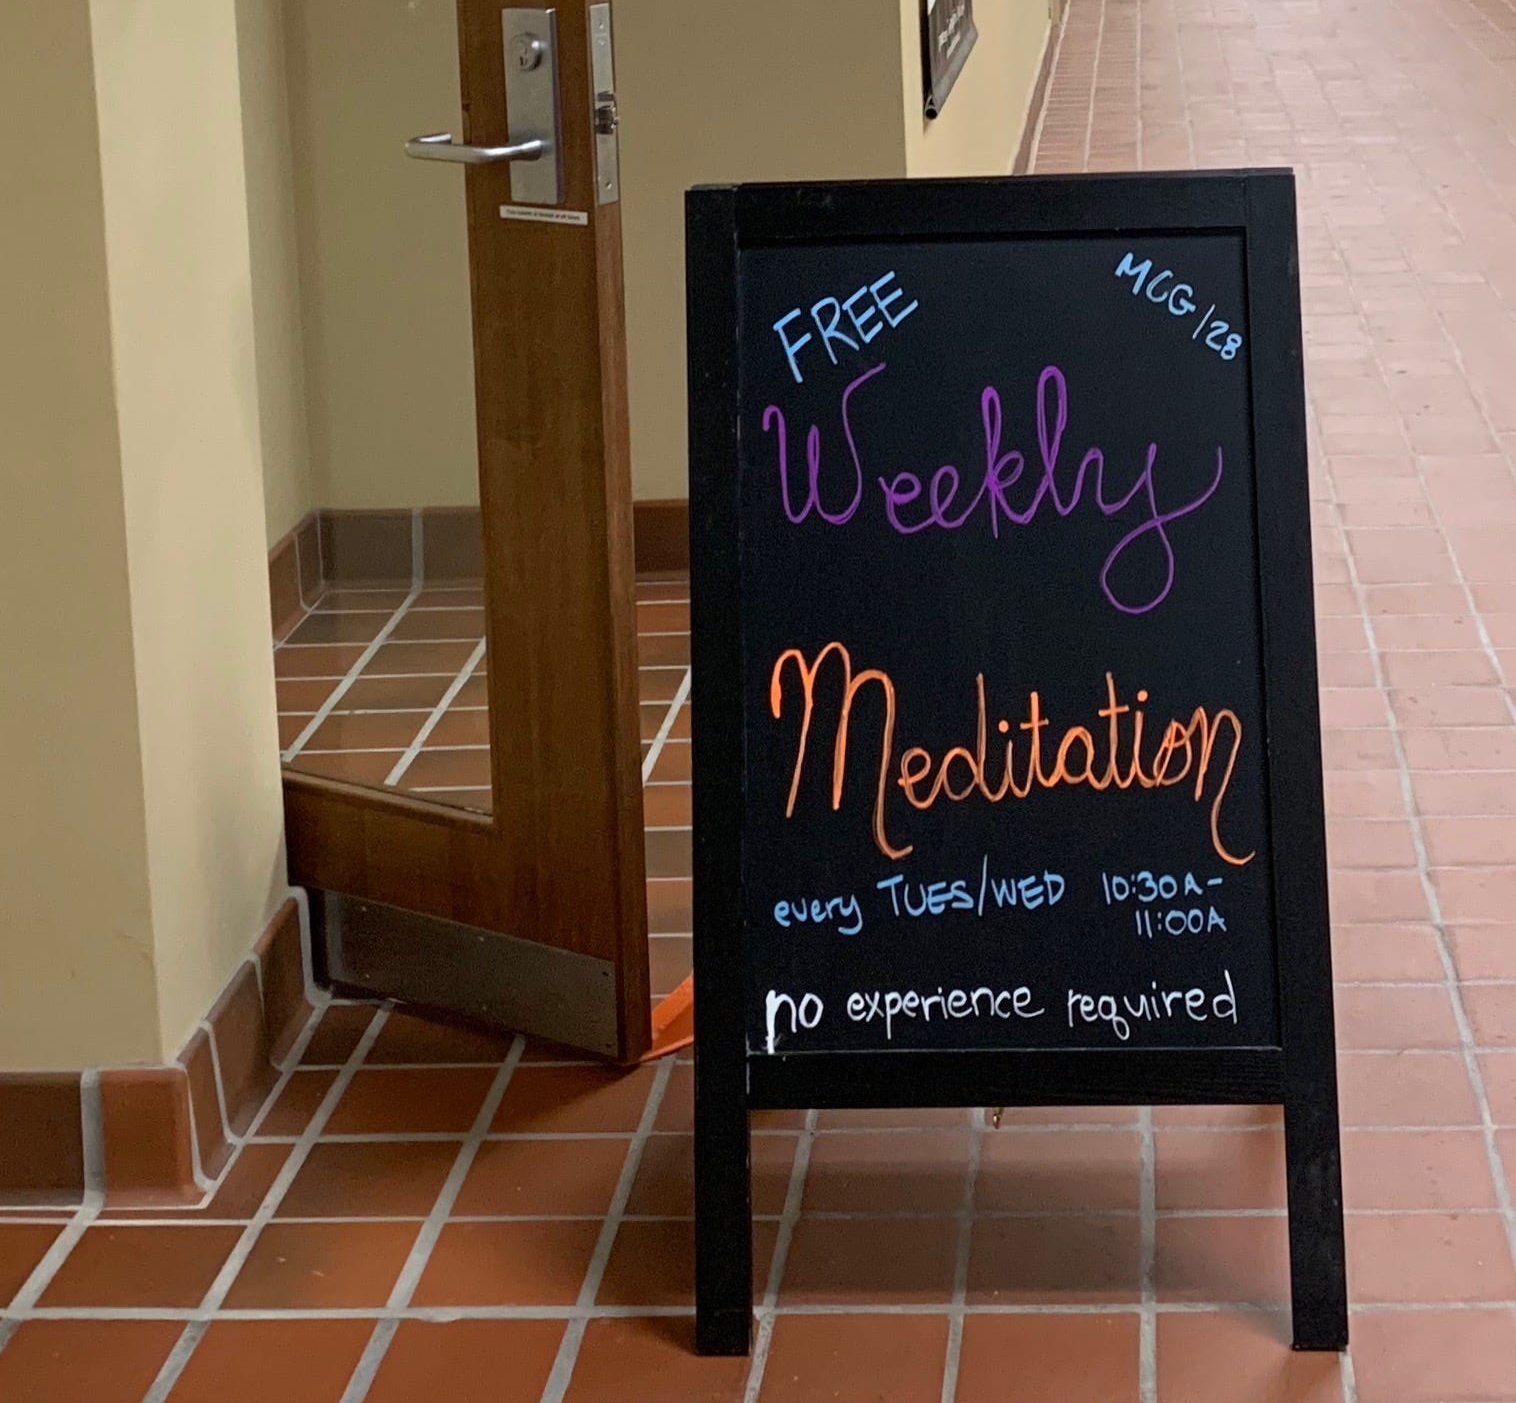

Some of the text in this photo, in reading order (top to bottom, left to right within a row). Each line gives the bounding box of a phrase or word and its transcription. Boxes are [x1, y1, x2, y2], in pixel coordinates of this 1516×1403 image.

[772, 270, 918, 383] FREE
[763, 362, 1222, 614] Weekly
[771, 641, 1256, 865] Meditation
[773, 892, 862, 935] every
[876, 854, 1065, 916] TUES/WED
[1136, 907, 1227, 938] 11:00A
[765, 970, 1239, 1055] no experience required
